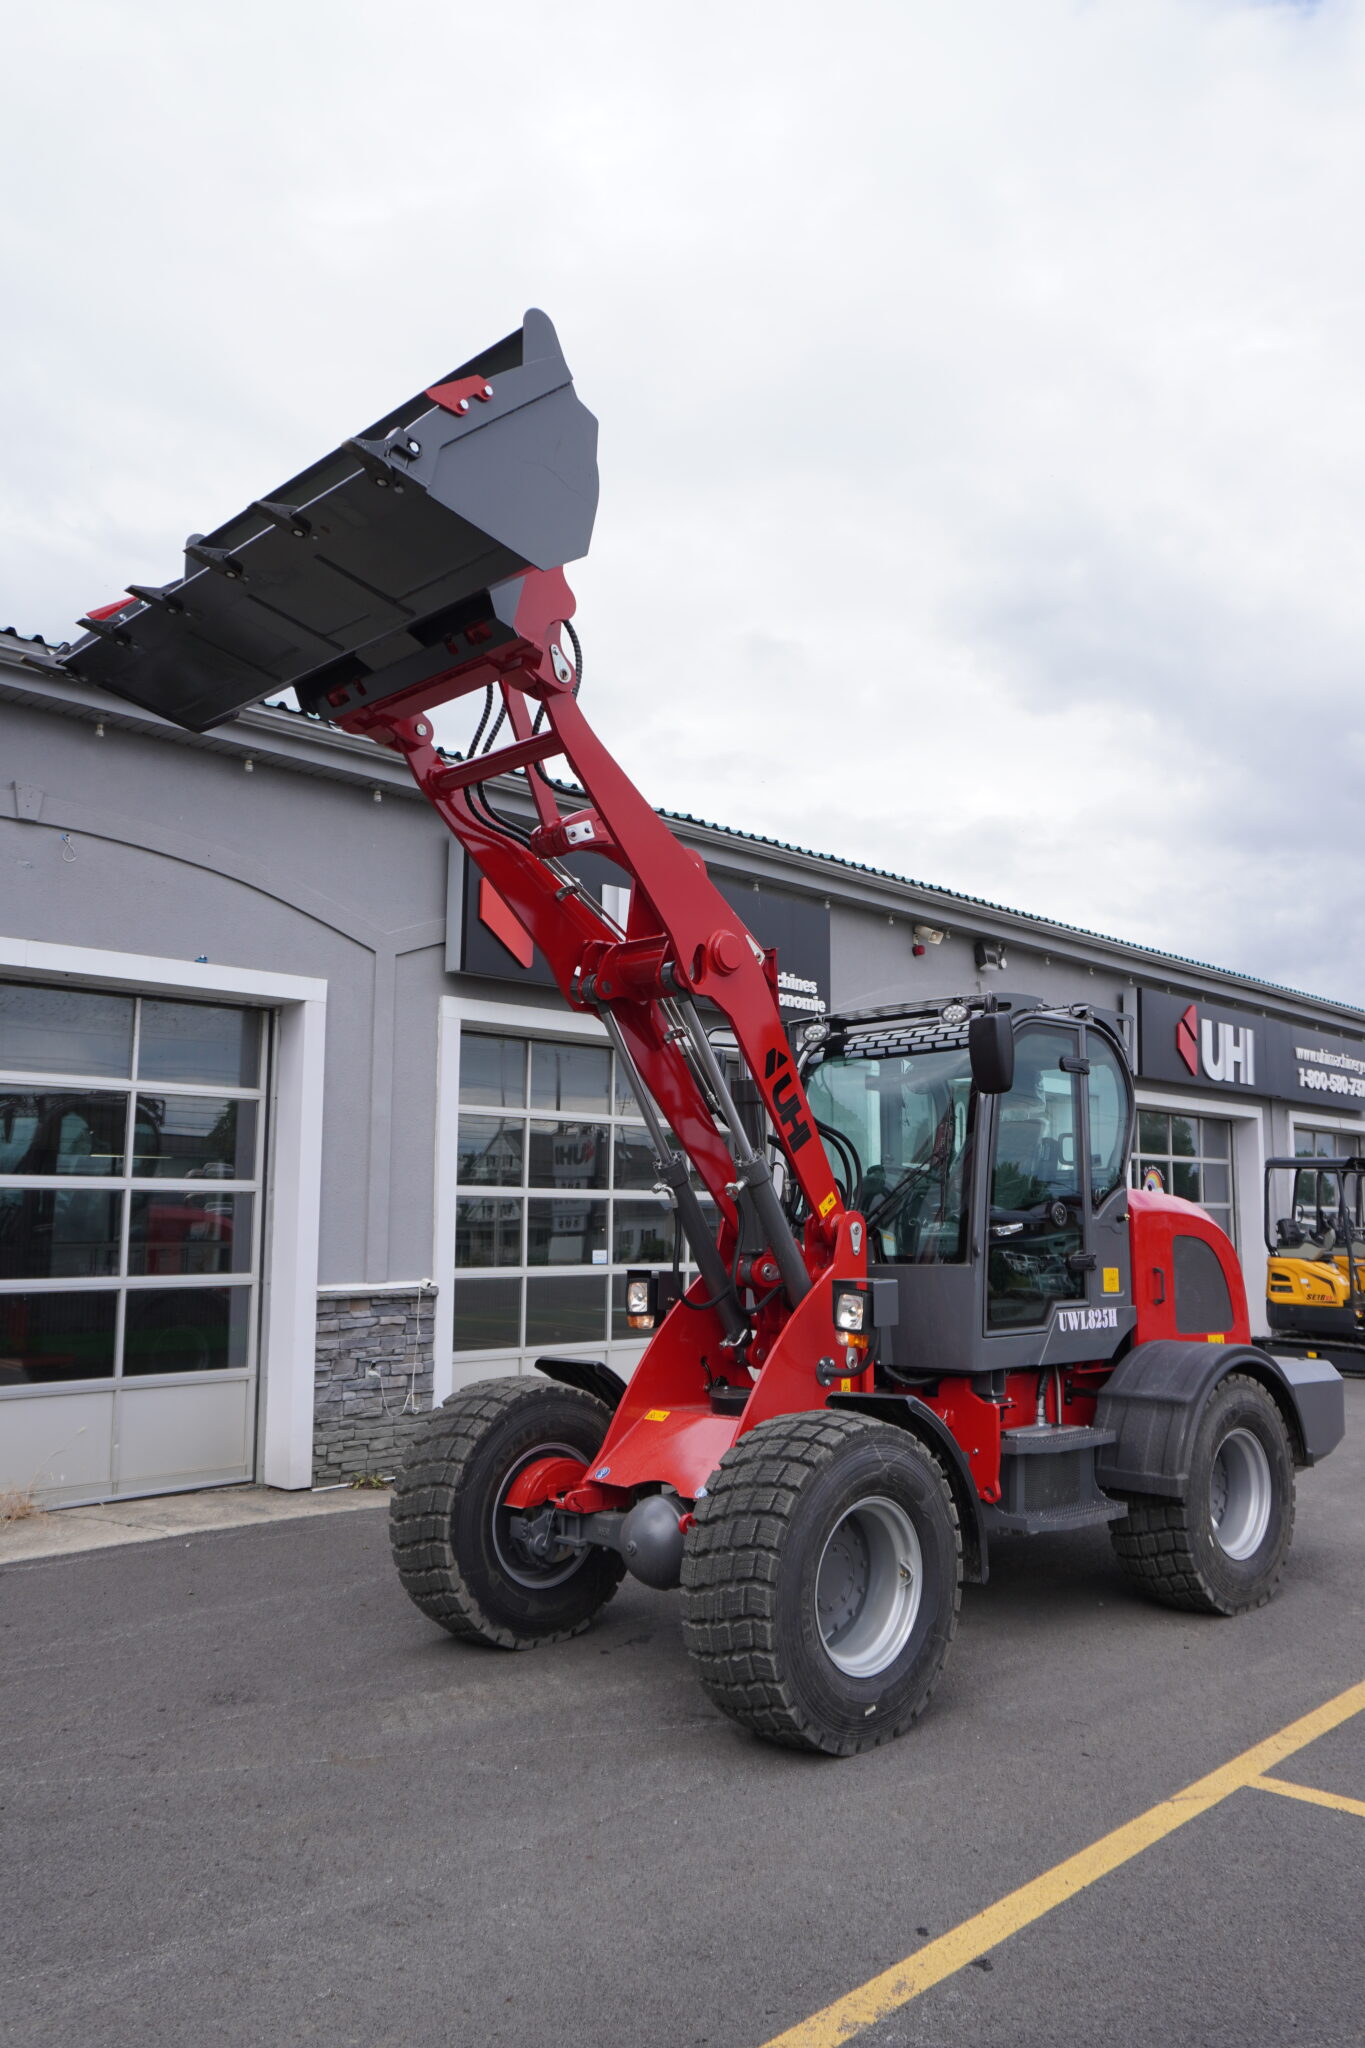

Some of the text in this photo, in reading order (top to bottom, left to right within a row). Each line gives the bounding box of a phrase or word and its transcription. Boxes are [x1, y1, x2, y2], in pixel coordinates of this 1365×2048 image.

[778, 972, 818, 994] chines
[779, 993, 826, 1012] onomie
[1201, 1018, 1255, 1085] UHI
[772, 1072, 812, 1154] UHI
[1059, 1309, 1118, 1332] UWL825H
